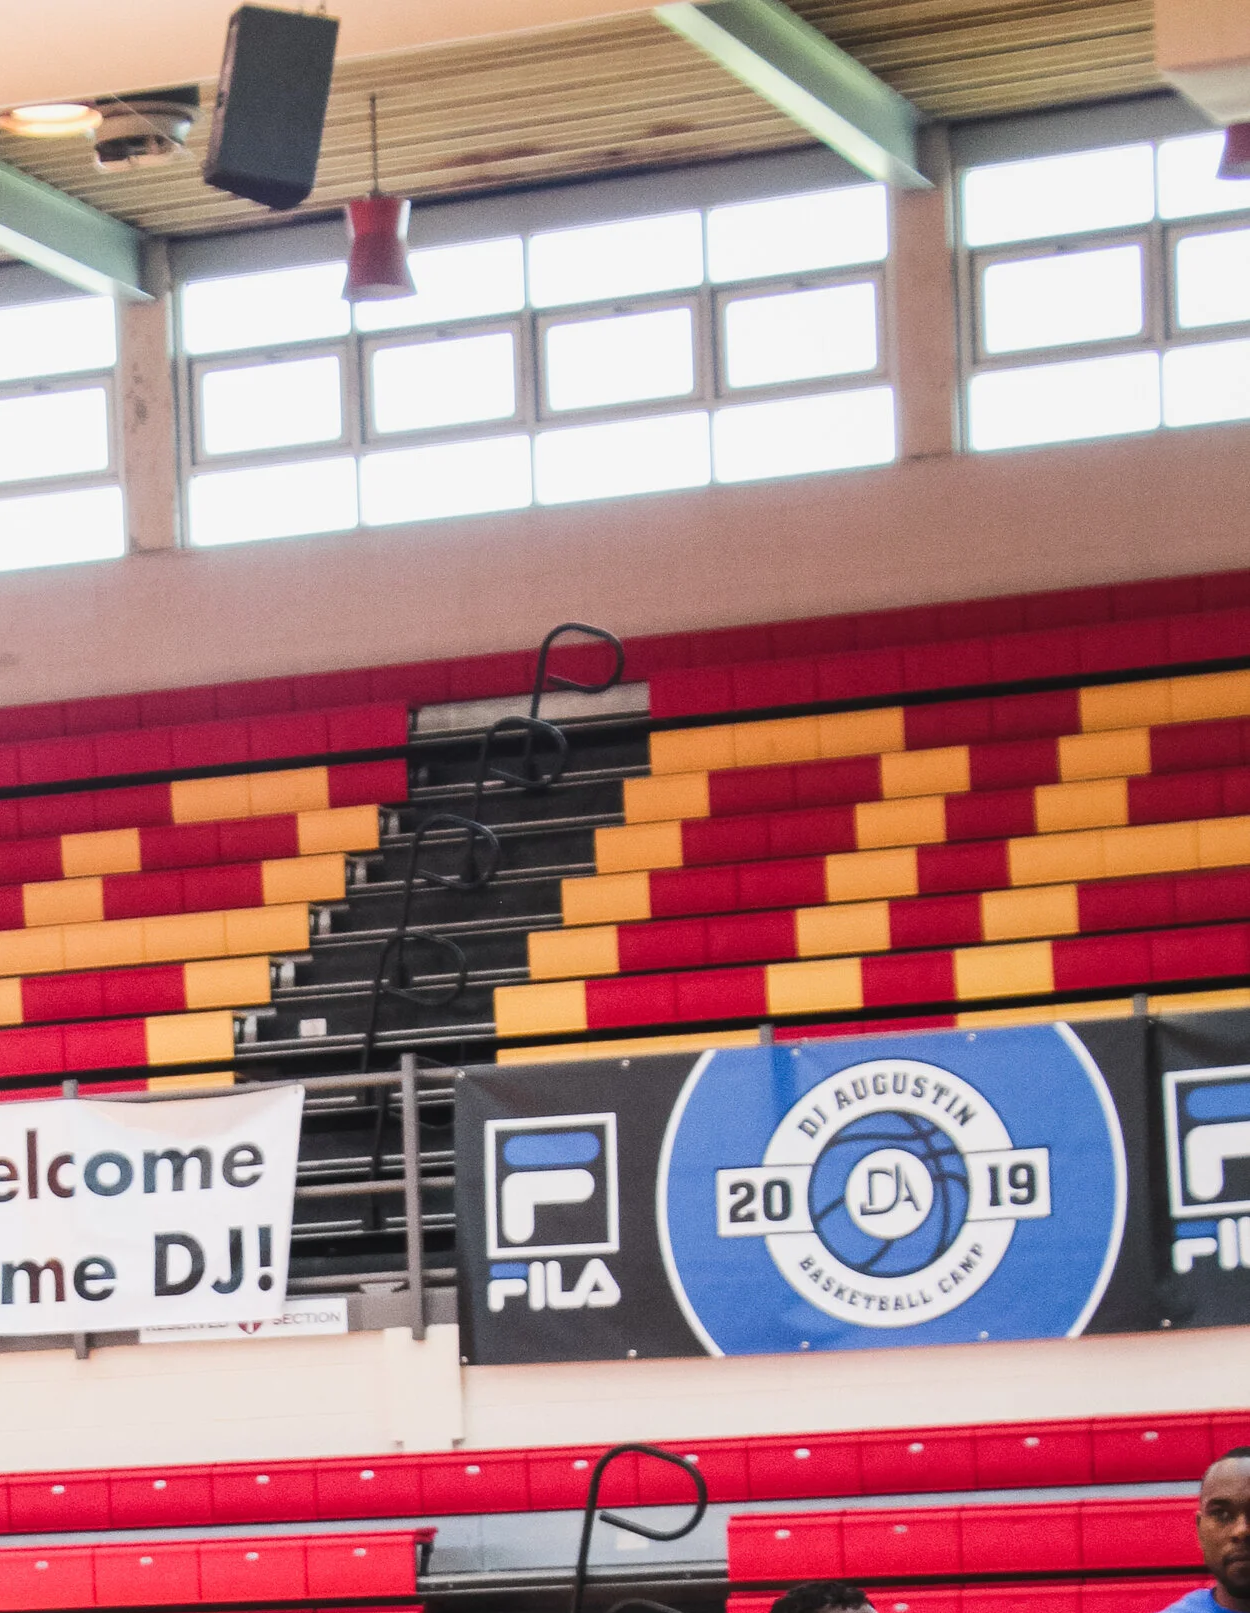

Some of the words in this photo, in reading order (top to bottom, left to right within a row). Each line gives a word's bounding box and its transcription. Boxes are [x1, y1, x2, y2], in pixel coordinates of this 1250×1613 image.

[798, 1106, 827, 1139] DJ
[833, 1071, 978, 1127] AUGUSTIN
[728, 1179, 792, 1223] 20
[987, 1161, 1038, 1206] 19
[154, 1226, 274, 1296] DJ!
[488, 1258, 621, 1312] FILA
[798, 1254, 933, 1312] BASKETBALL
[938, 1242, 985, 1294] CAMP
[273, 1312, 340, 1325] SECTION
